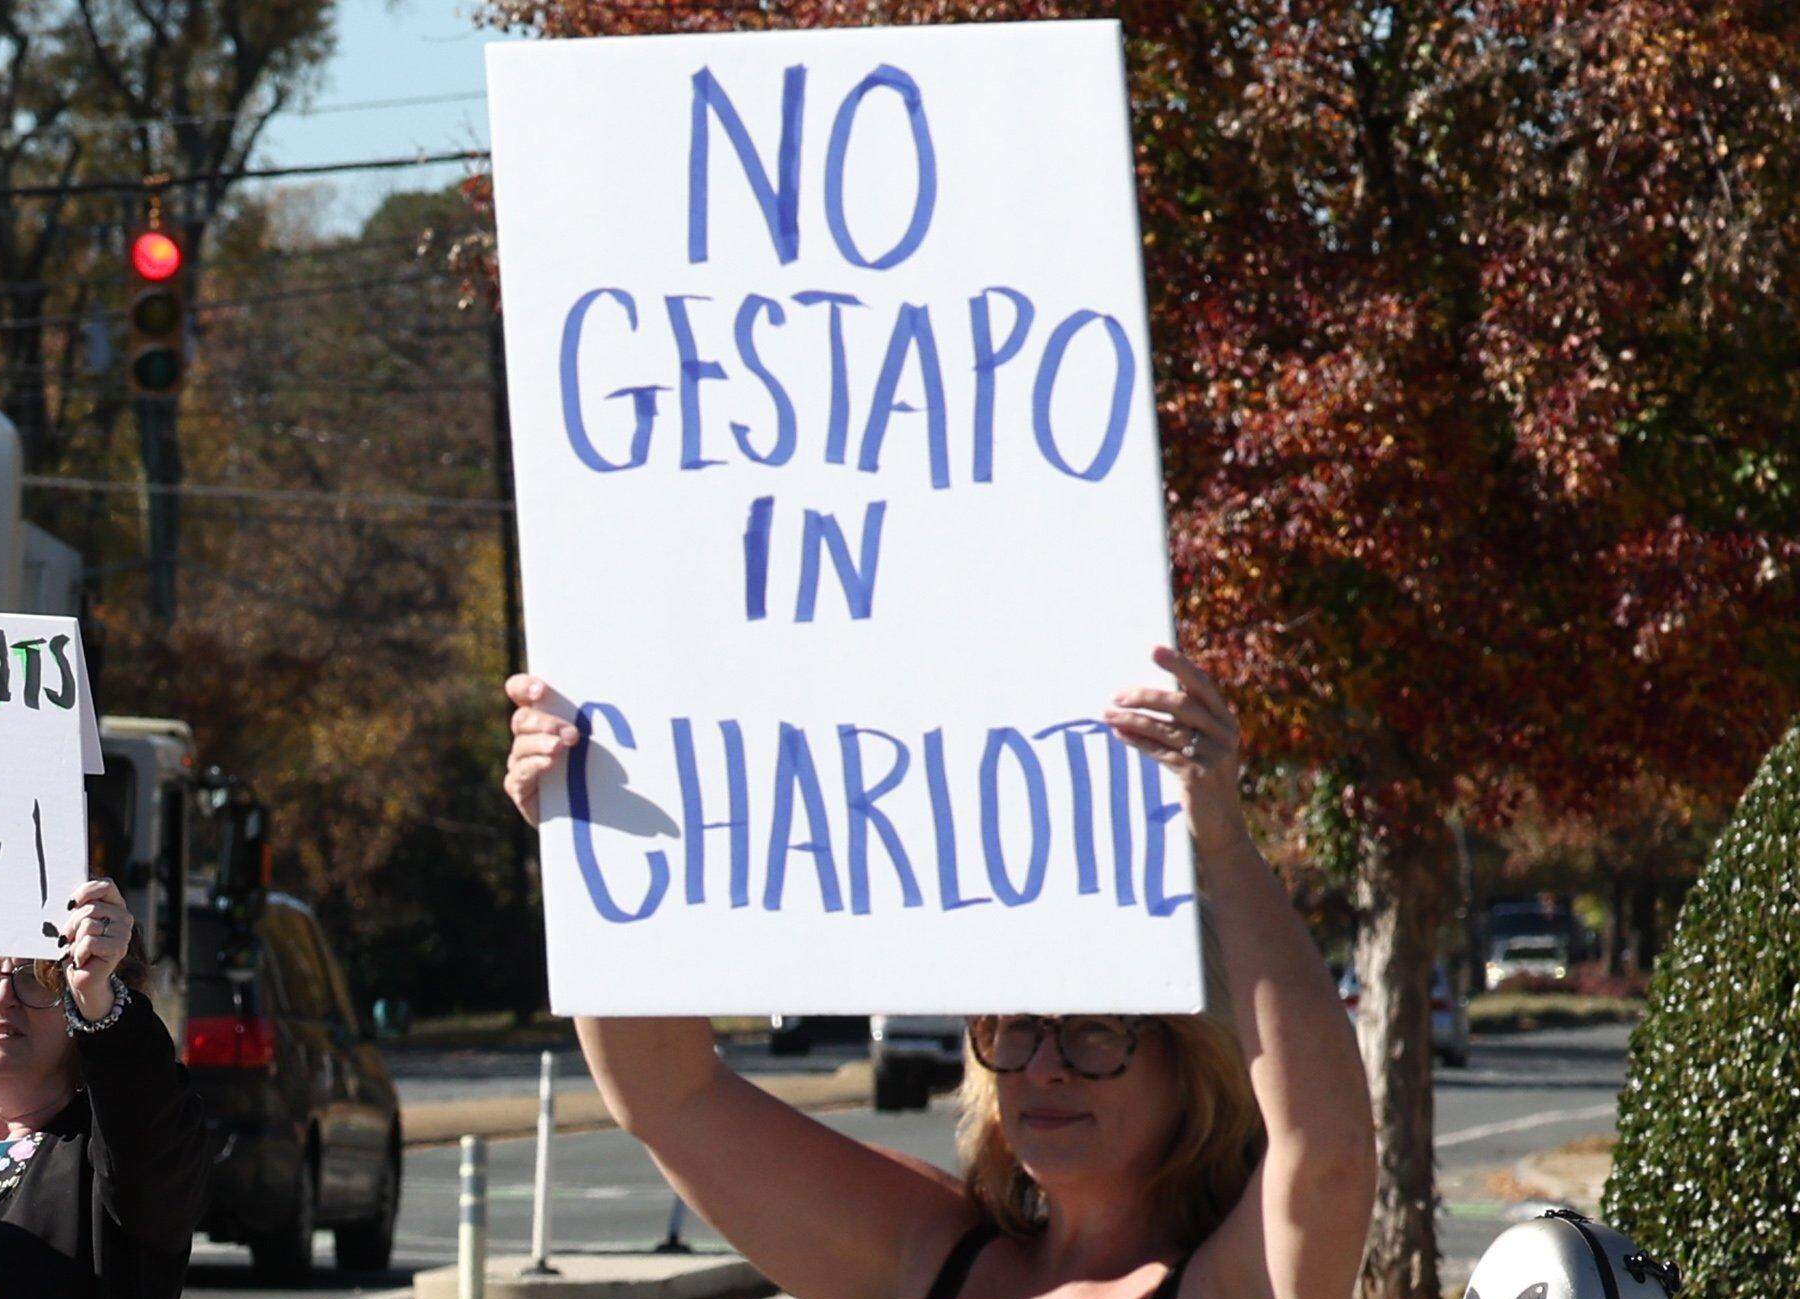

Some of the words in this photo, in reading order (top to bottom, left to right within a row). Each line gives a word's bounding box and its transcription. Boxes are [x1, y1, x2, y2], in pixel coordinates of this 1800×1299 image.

[688, 64, 937, 270] NO
[559, 285, 1136, 489] GESTAPO
[743, 495, 887, 622] IN
[566, 701, 1194, 923] CHARLOTTE
